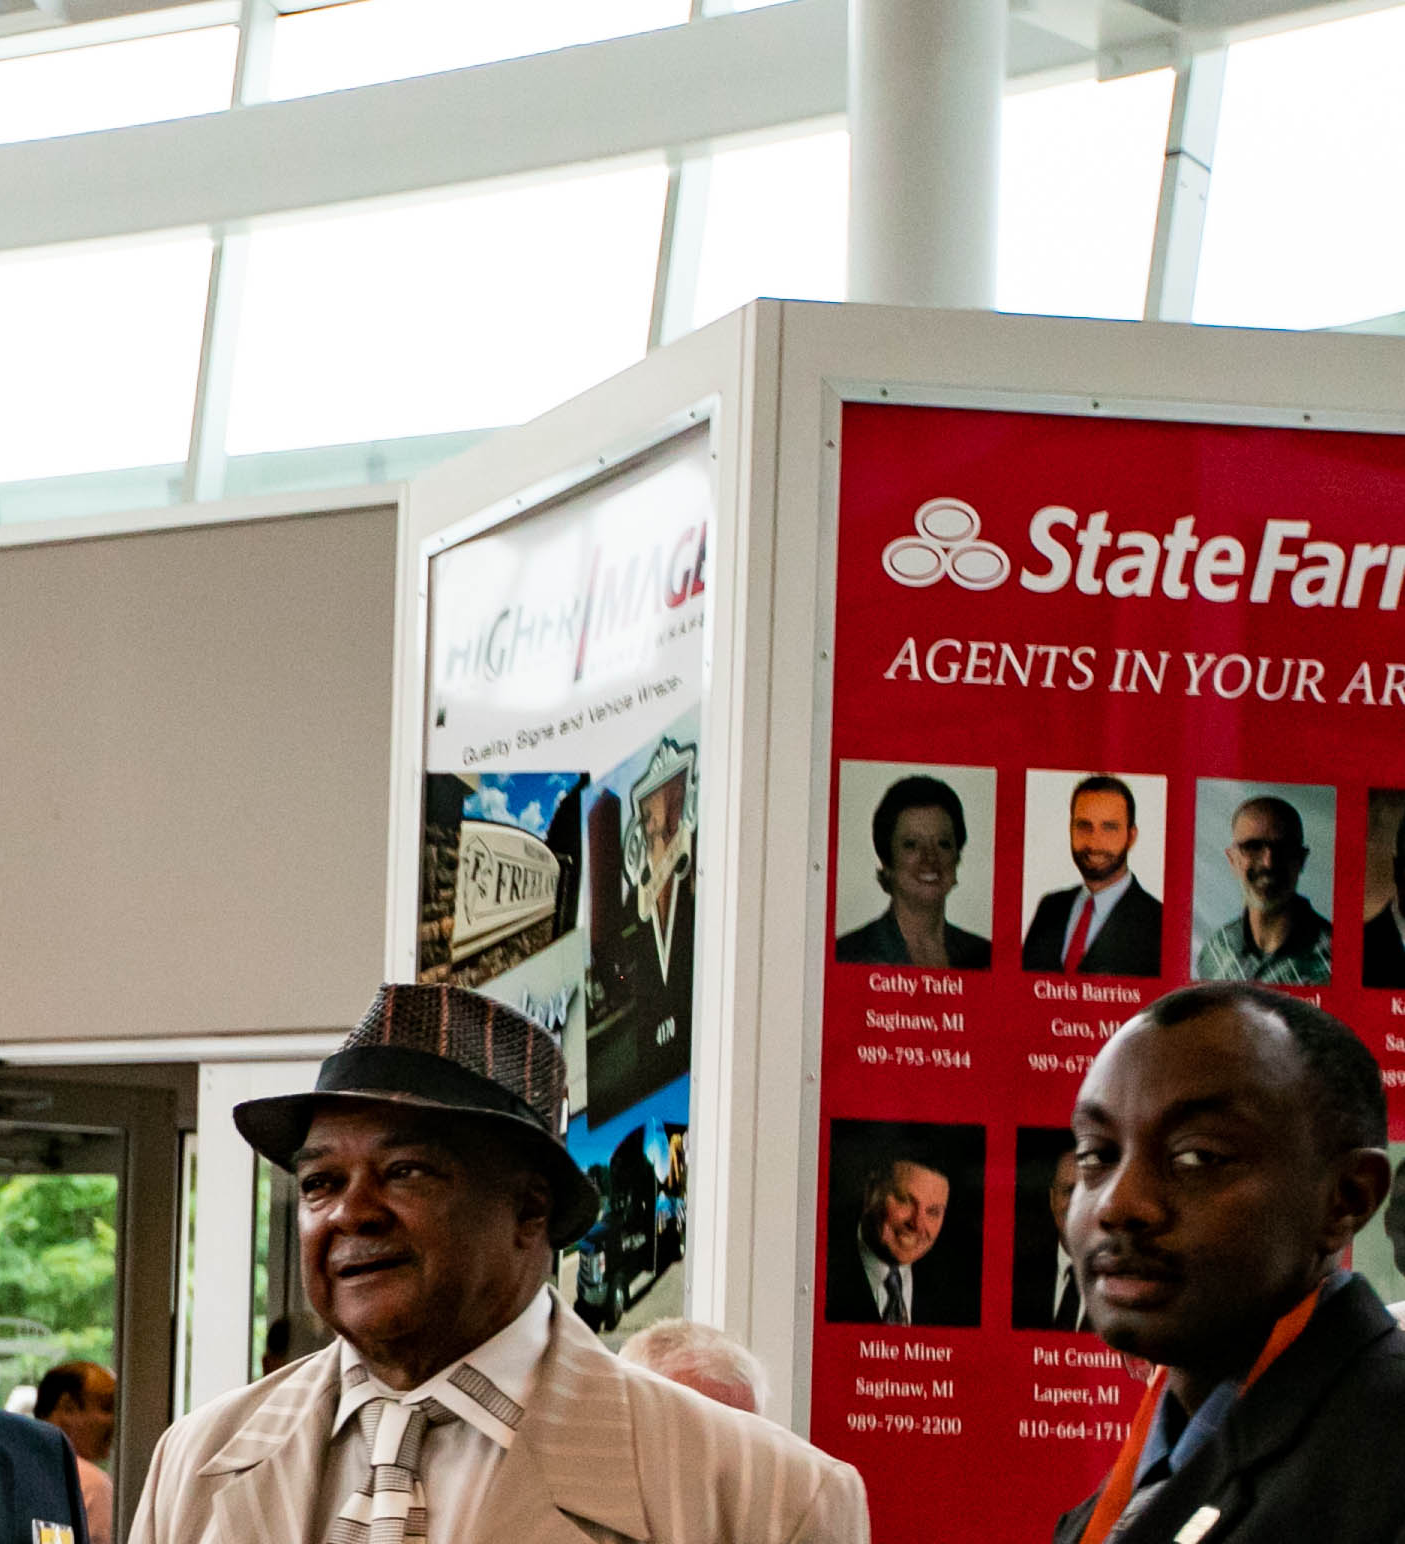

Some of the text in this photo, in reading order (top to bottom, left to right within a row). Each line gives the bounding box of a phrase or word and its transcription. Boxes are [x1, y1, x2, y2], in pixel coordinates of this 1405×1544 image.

[883, 636, 1096, 691] AGENTS
[1108, 647, 1171, 694] IN
[1182, 651, 1327, 703] YOUR
[462, 740, 512, 766] Quality
[869, 972, 963, 997] Cathy Tafel
[1033, 979, 1141, 1003] Chris Barrios
[865, 1008, 965, 1033] Saginaw, MI
[1051, 1017, 1095, 1040] Caro,
[859, 1340, 953, 1362] Mike Miner
[1033, 1347, 1122, 1368] Pat Cronin
[856, 1377, 954, 1400] Saginaw, MI
[1034, 1382, 1120, 1407] Lapeer, MI
